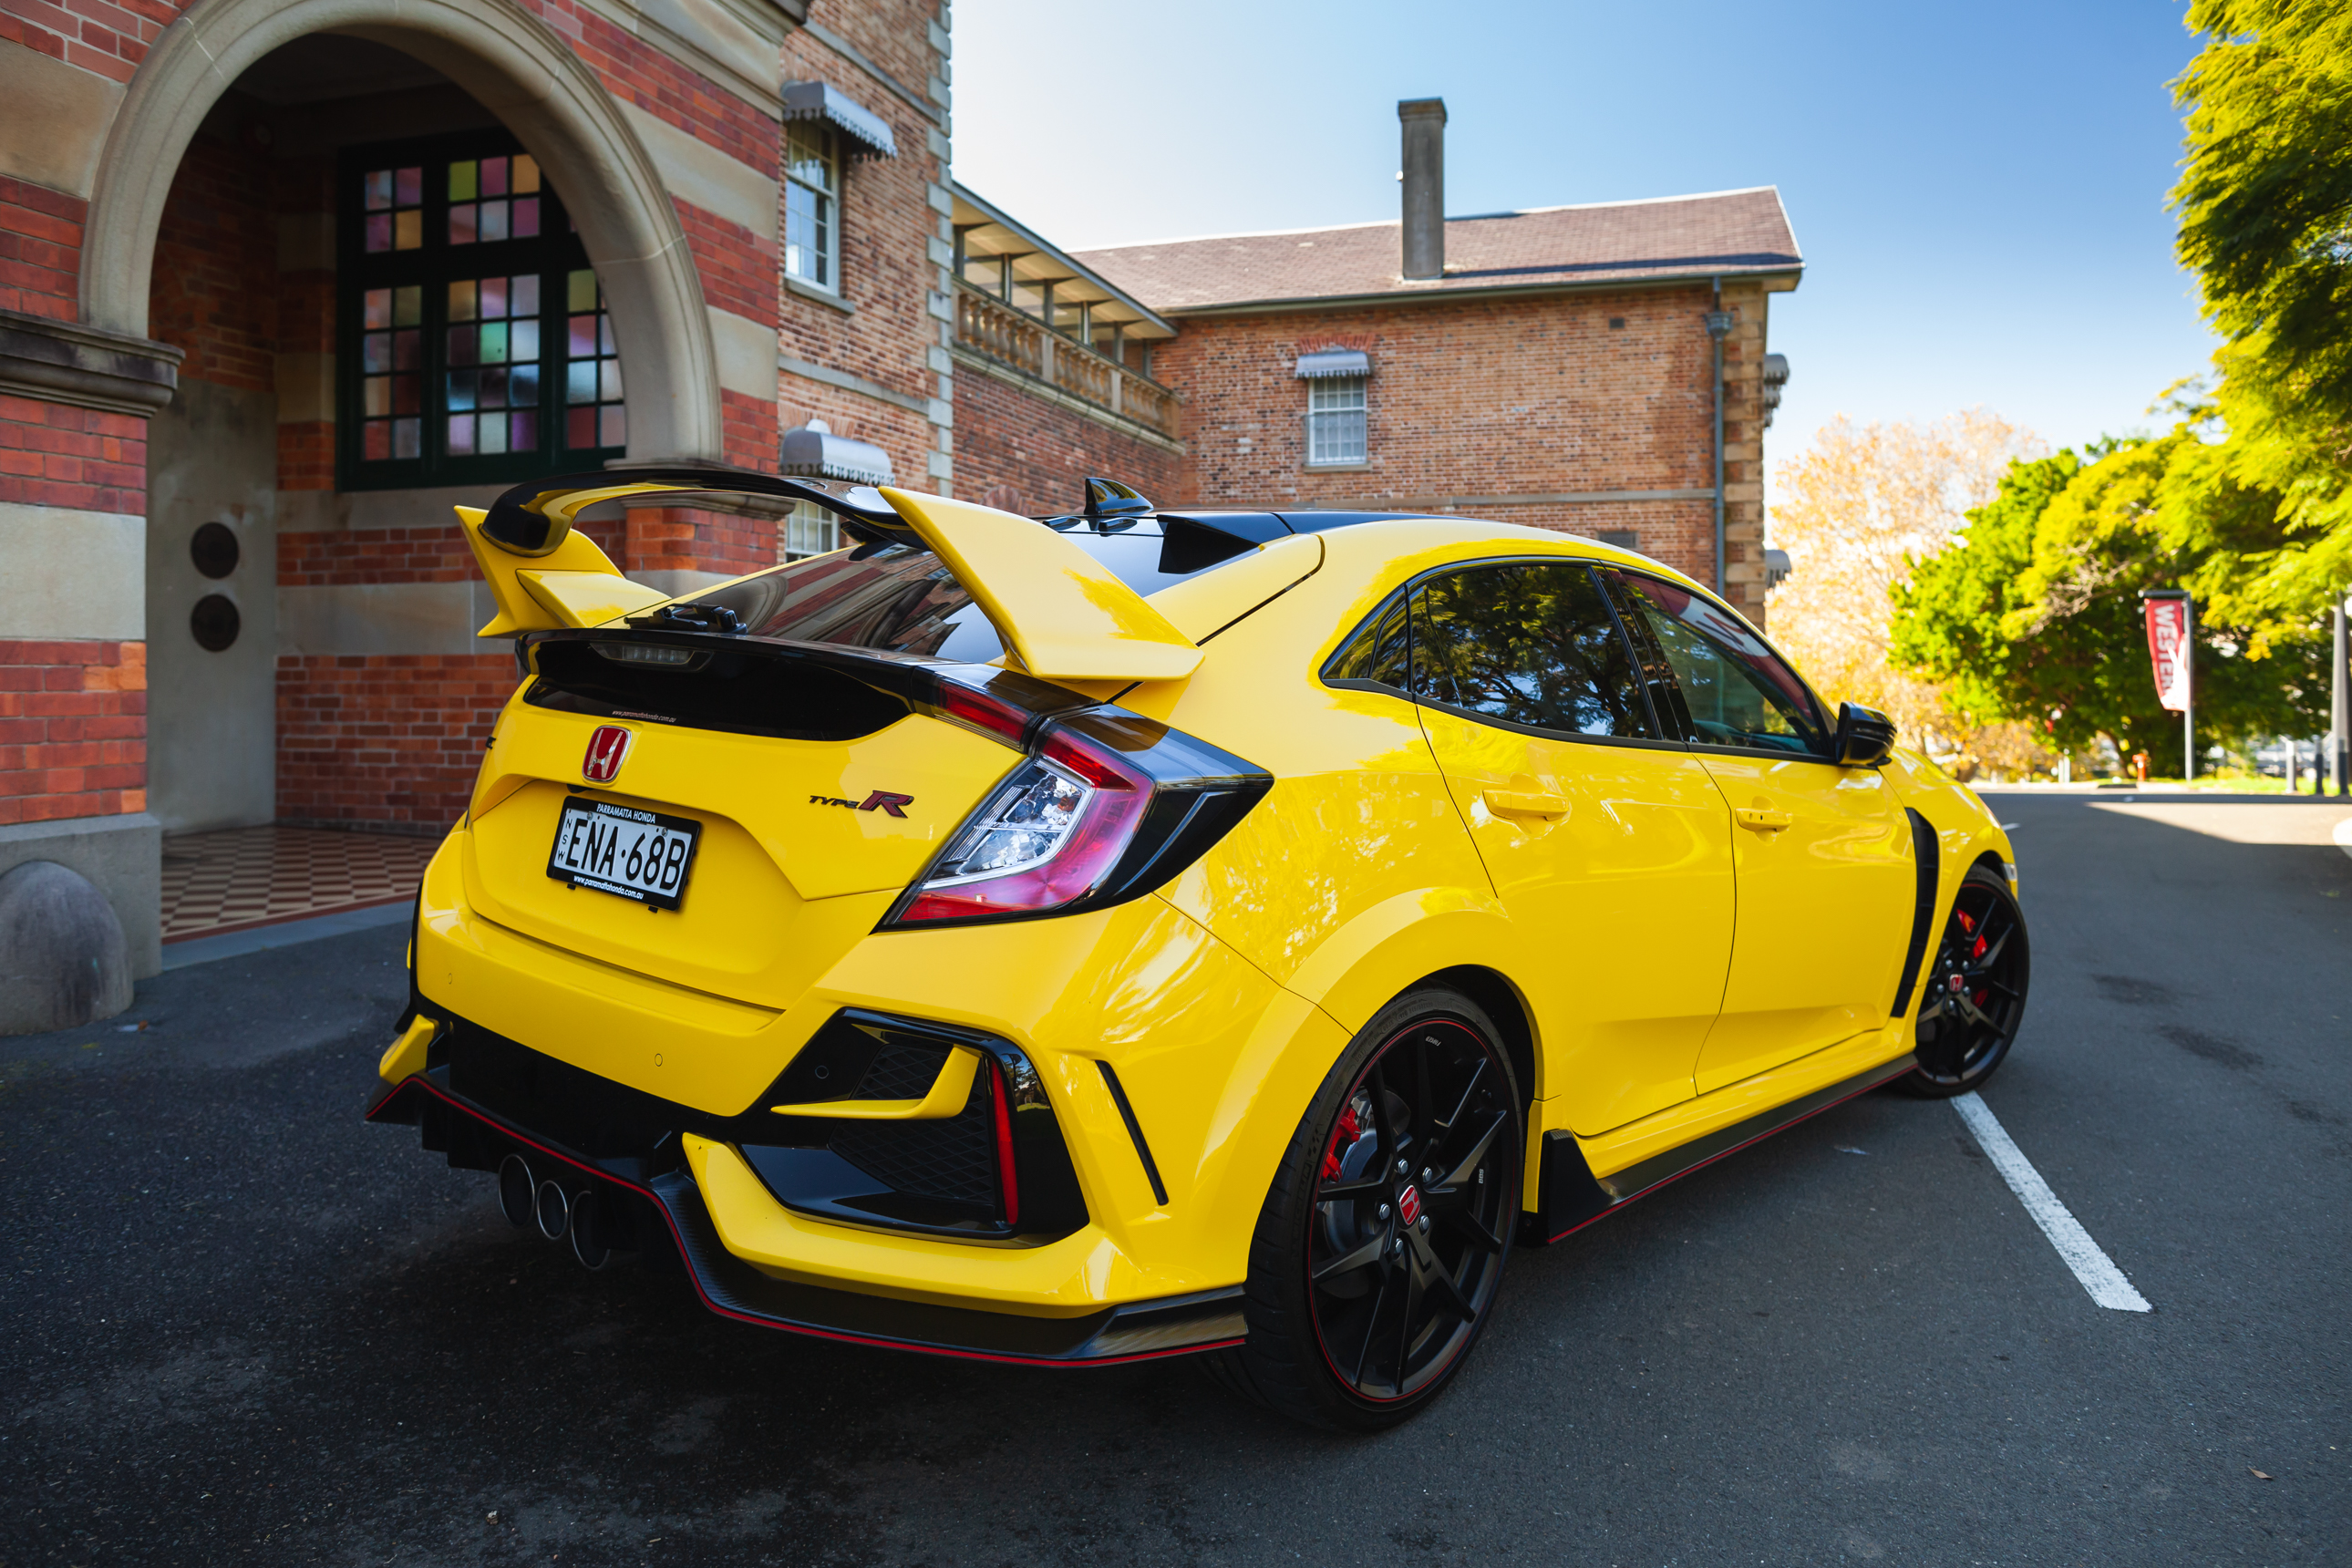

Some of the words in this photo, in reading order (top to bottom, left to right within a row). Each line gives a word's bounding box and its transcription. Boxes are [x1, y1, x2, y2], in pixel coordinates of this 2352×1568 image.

[2154, 604, 2176, 694] WESTER
[596, 803, 633, 820] PARRAMATTA
[633, 810, 655, 823] HONDA
[809, 795, 860, 810] TYPE
[573, 875, 645, 900] www.parramattahonda.com.au
